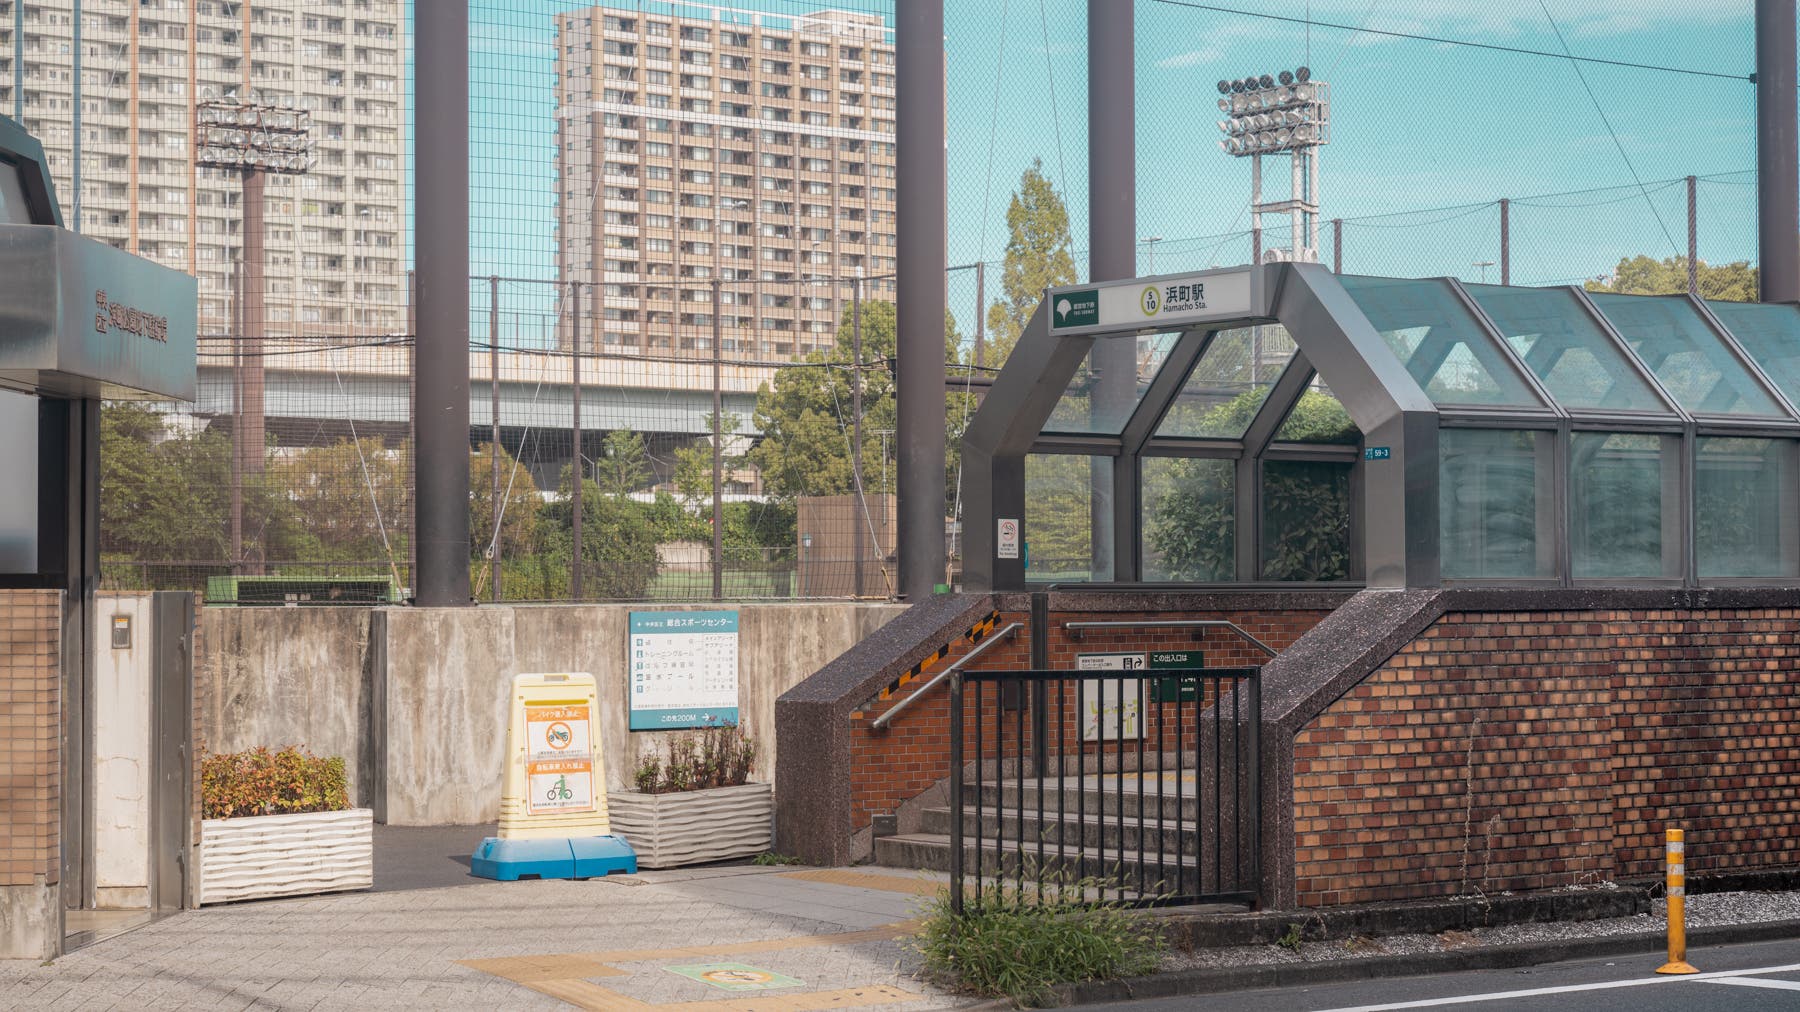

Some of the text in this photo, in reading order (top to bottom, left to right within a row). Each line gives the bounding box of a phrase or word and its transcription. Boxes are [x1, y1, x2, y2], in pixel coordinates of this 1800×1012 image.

[1166, 283, 1204, 303] 浜町駅
[1146, 300, 1156, 310] 10
[1163, 301, 1208, 312] Hamacho Sta.
[666, 617, 734, 628] 総合スポーツセンター
[1153, 654, 1188, 663] この出入口は
